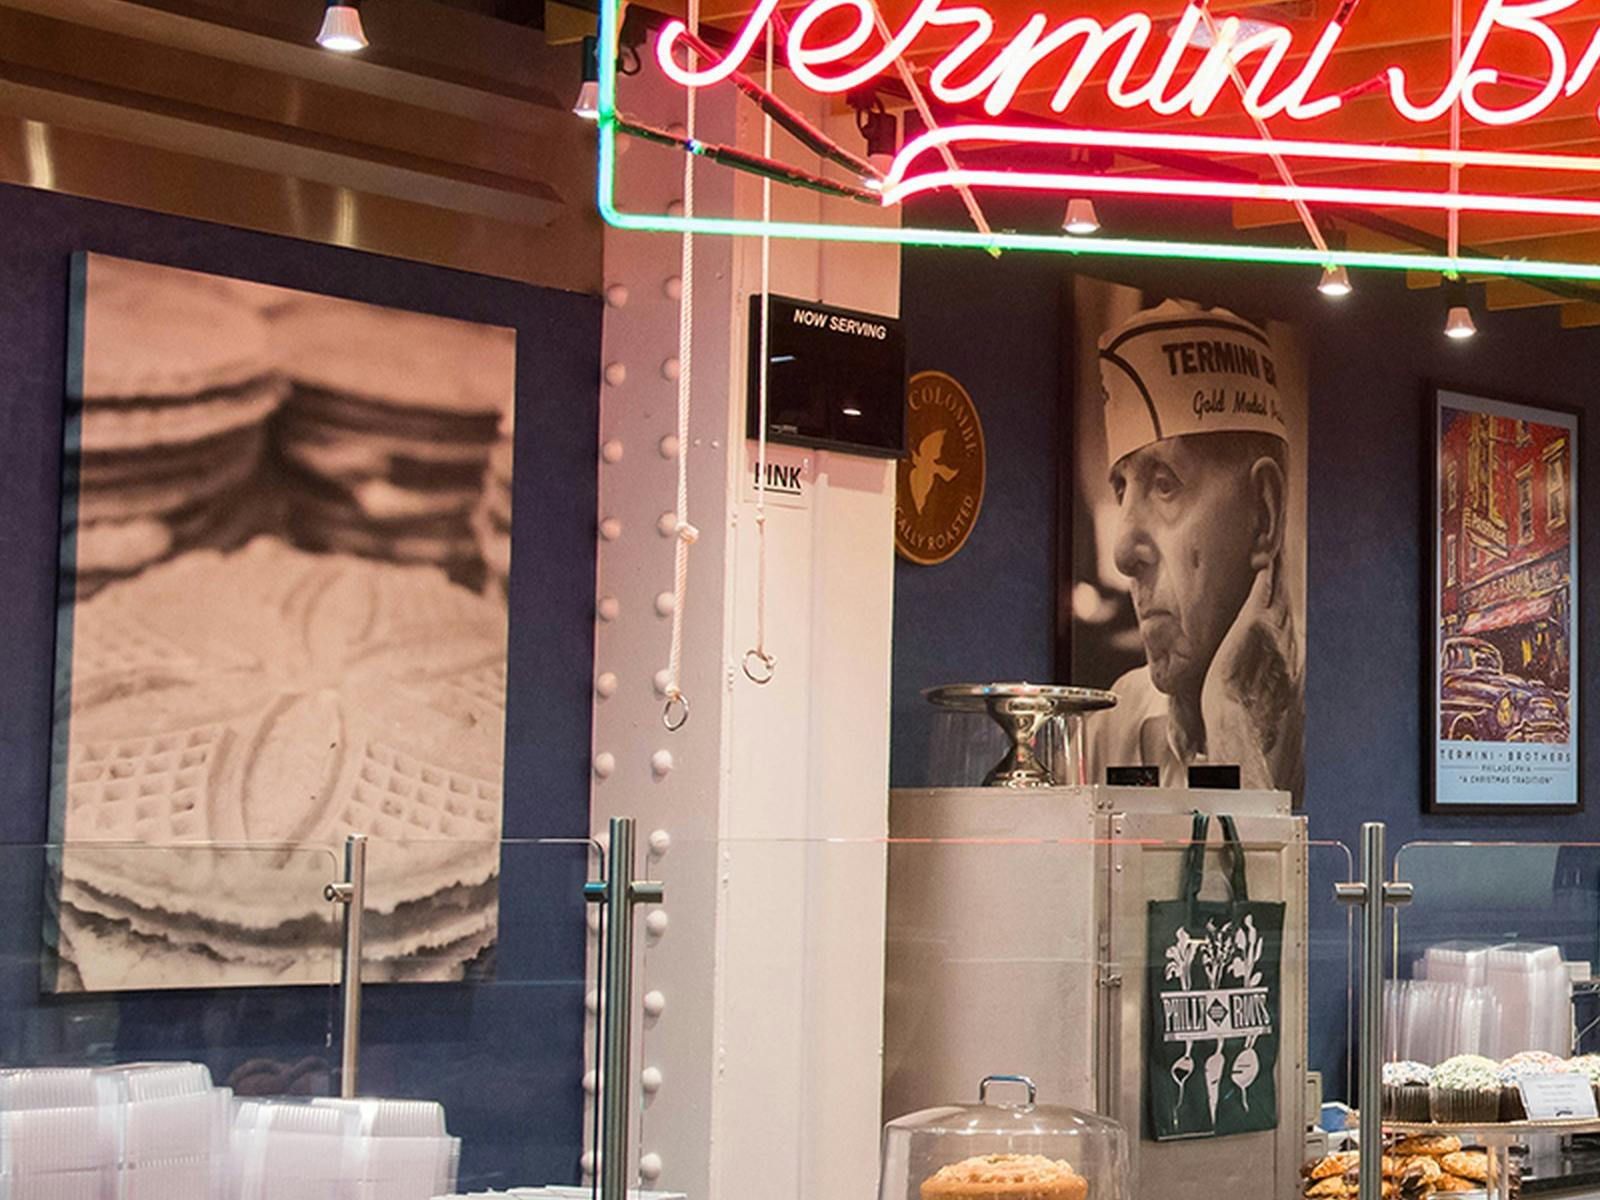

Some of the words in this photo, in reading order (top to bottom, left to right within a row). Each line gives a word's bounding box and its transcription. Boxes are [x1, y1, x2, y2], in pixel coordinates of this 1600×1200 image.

[793, 308, 828, 329] NOW
[829, 316, 887, 340] SERVING
[1161, 340, 1260, 379] TERMINI
[1193, 388, 1225, 420] Gold
[908, 386, 977, 457] COLOMBE
[754, 462, 802, 489] PINK
[926, 495, 975, 551] ROASTED
[1440, 749, 1495, 761] TERMINI
[1507, 751, 1572, 763] BROTHERS
[1481, 764, 1532, 773] PHILADELPHIA
[1470, 775, 1511, 784] CHRISTMAS
[1163, 997, 1206, 1031] PHILLY
[1233, 994, 1270, 1027] ROOTS
